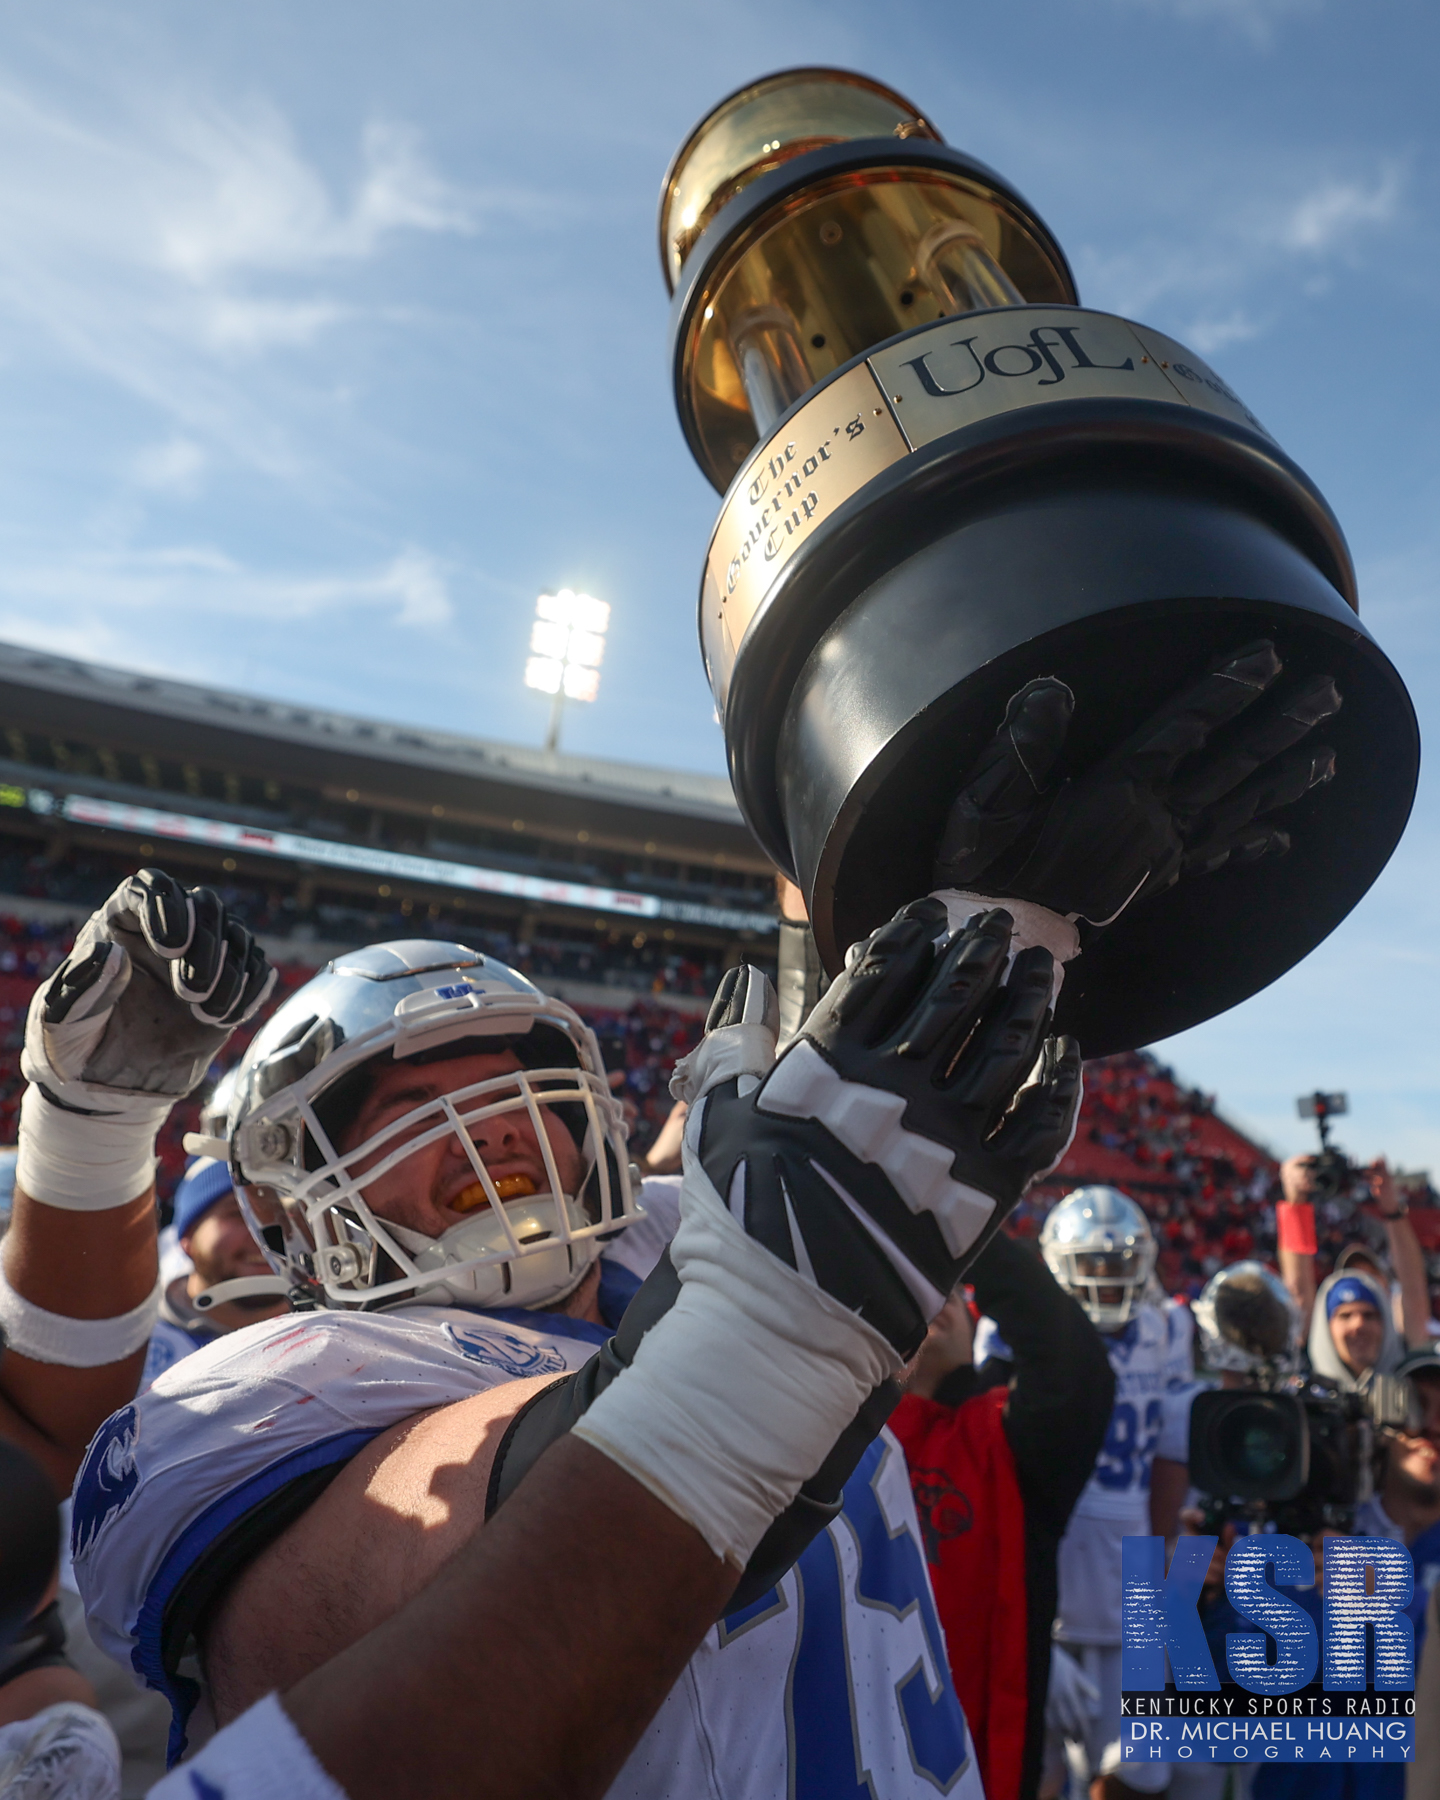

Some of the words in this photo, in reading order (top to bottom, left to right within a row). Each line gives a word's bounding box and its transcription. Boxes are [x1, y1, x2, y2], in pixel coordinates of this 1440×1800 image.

[898, 326, 1135, 397] UofL
[726, 412, 866, 594] Governor's
[747, 441, 798, 506] The
[763, 489, 819, 562] Cup
